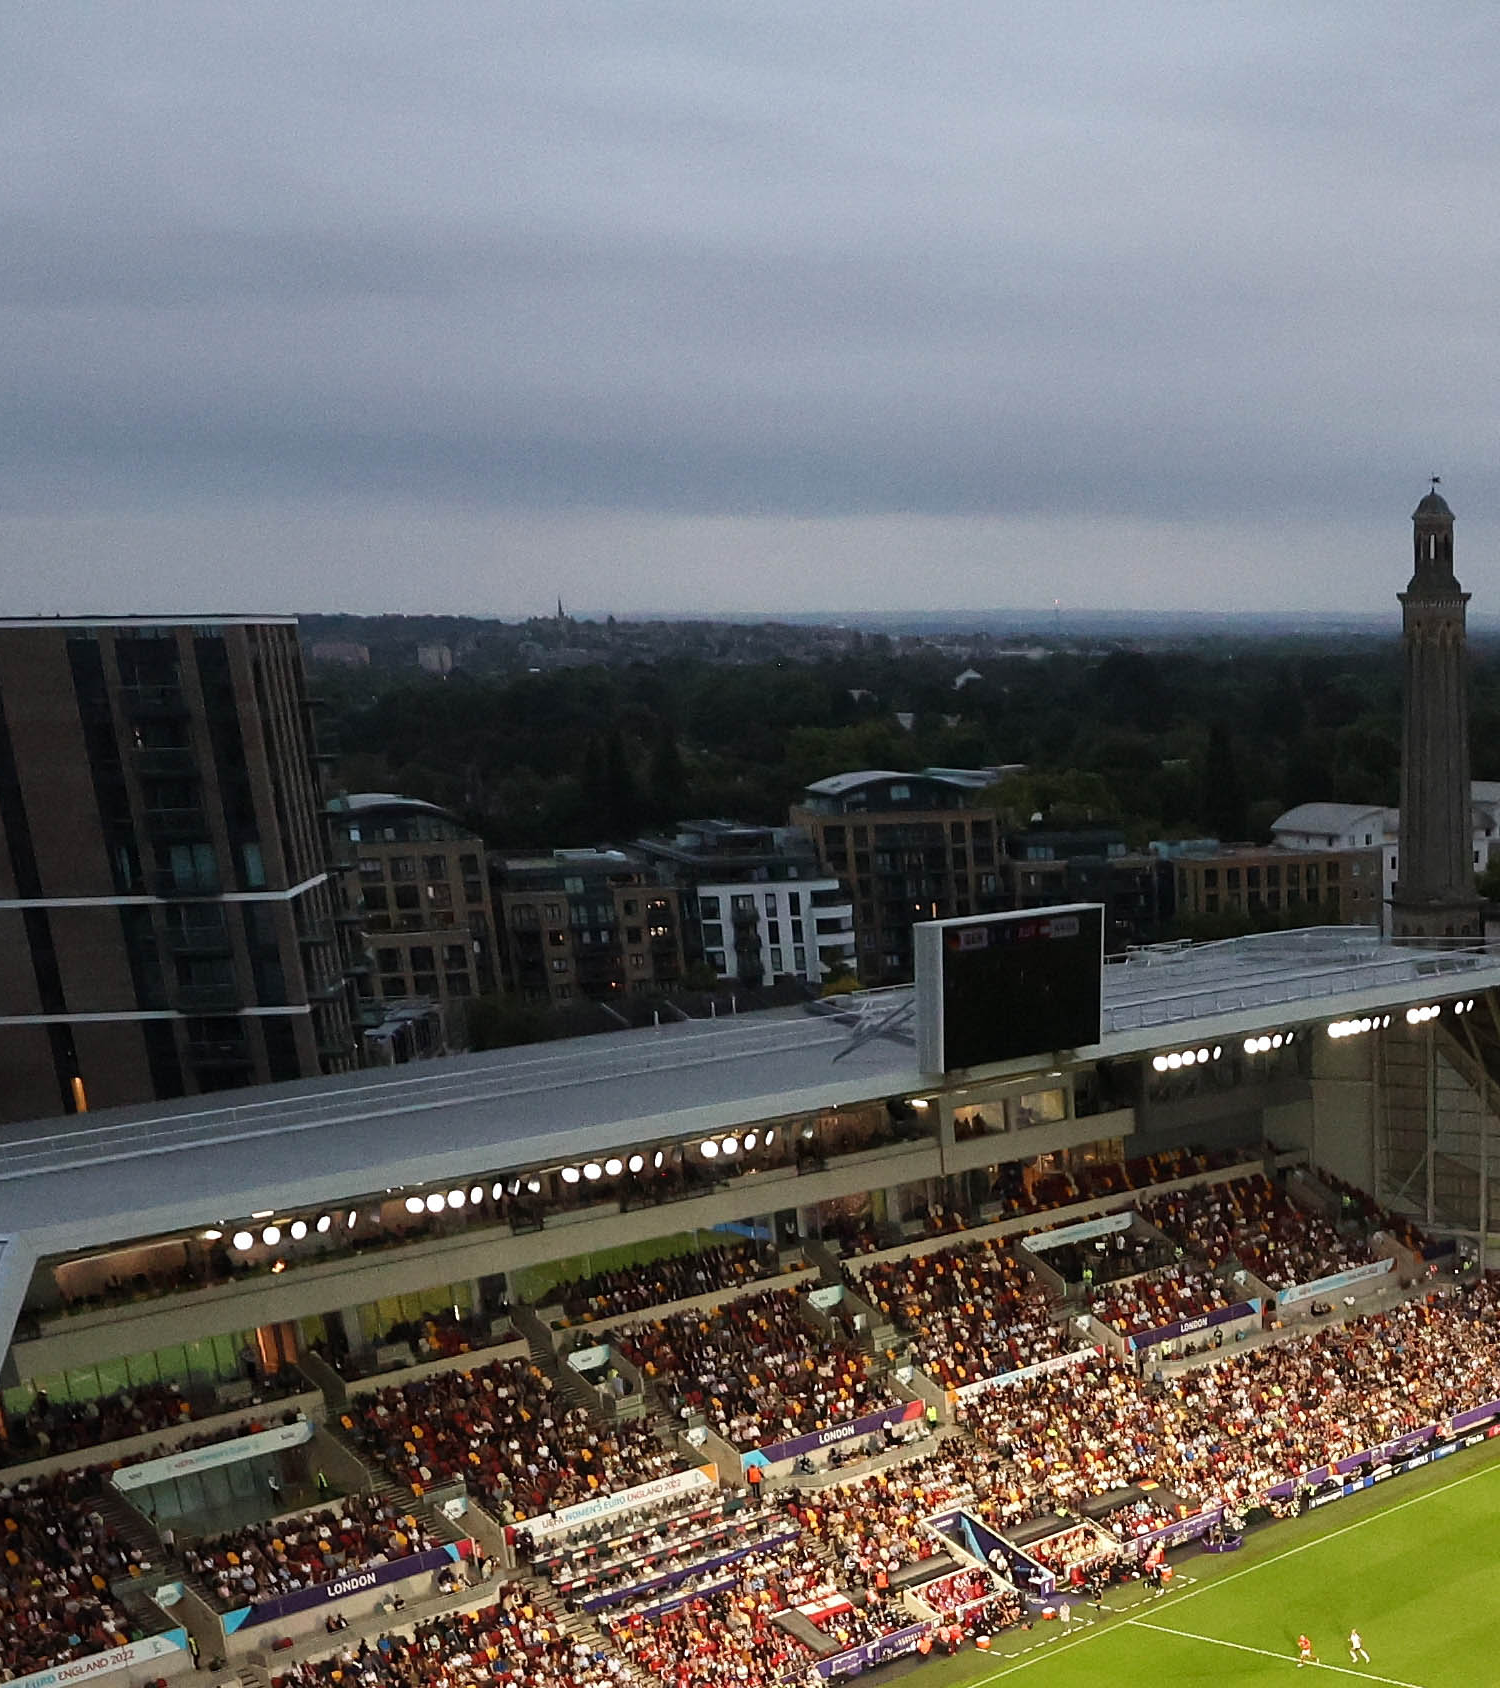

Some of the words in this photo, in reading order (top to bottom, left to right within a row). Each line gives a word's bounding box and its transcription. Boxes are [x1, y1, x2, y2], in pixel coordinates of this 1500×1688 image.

[1180, 1316, 1208, 1333] LONDON
[819, 1424, 855, 1445] LONDON
[327, 1572, 377, 1597] LONDON
[57, 1658, 109, 1680] ENGLAND
[110, 1649, 135, 1665] 2022
